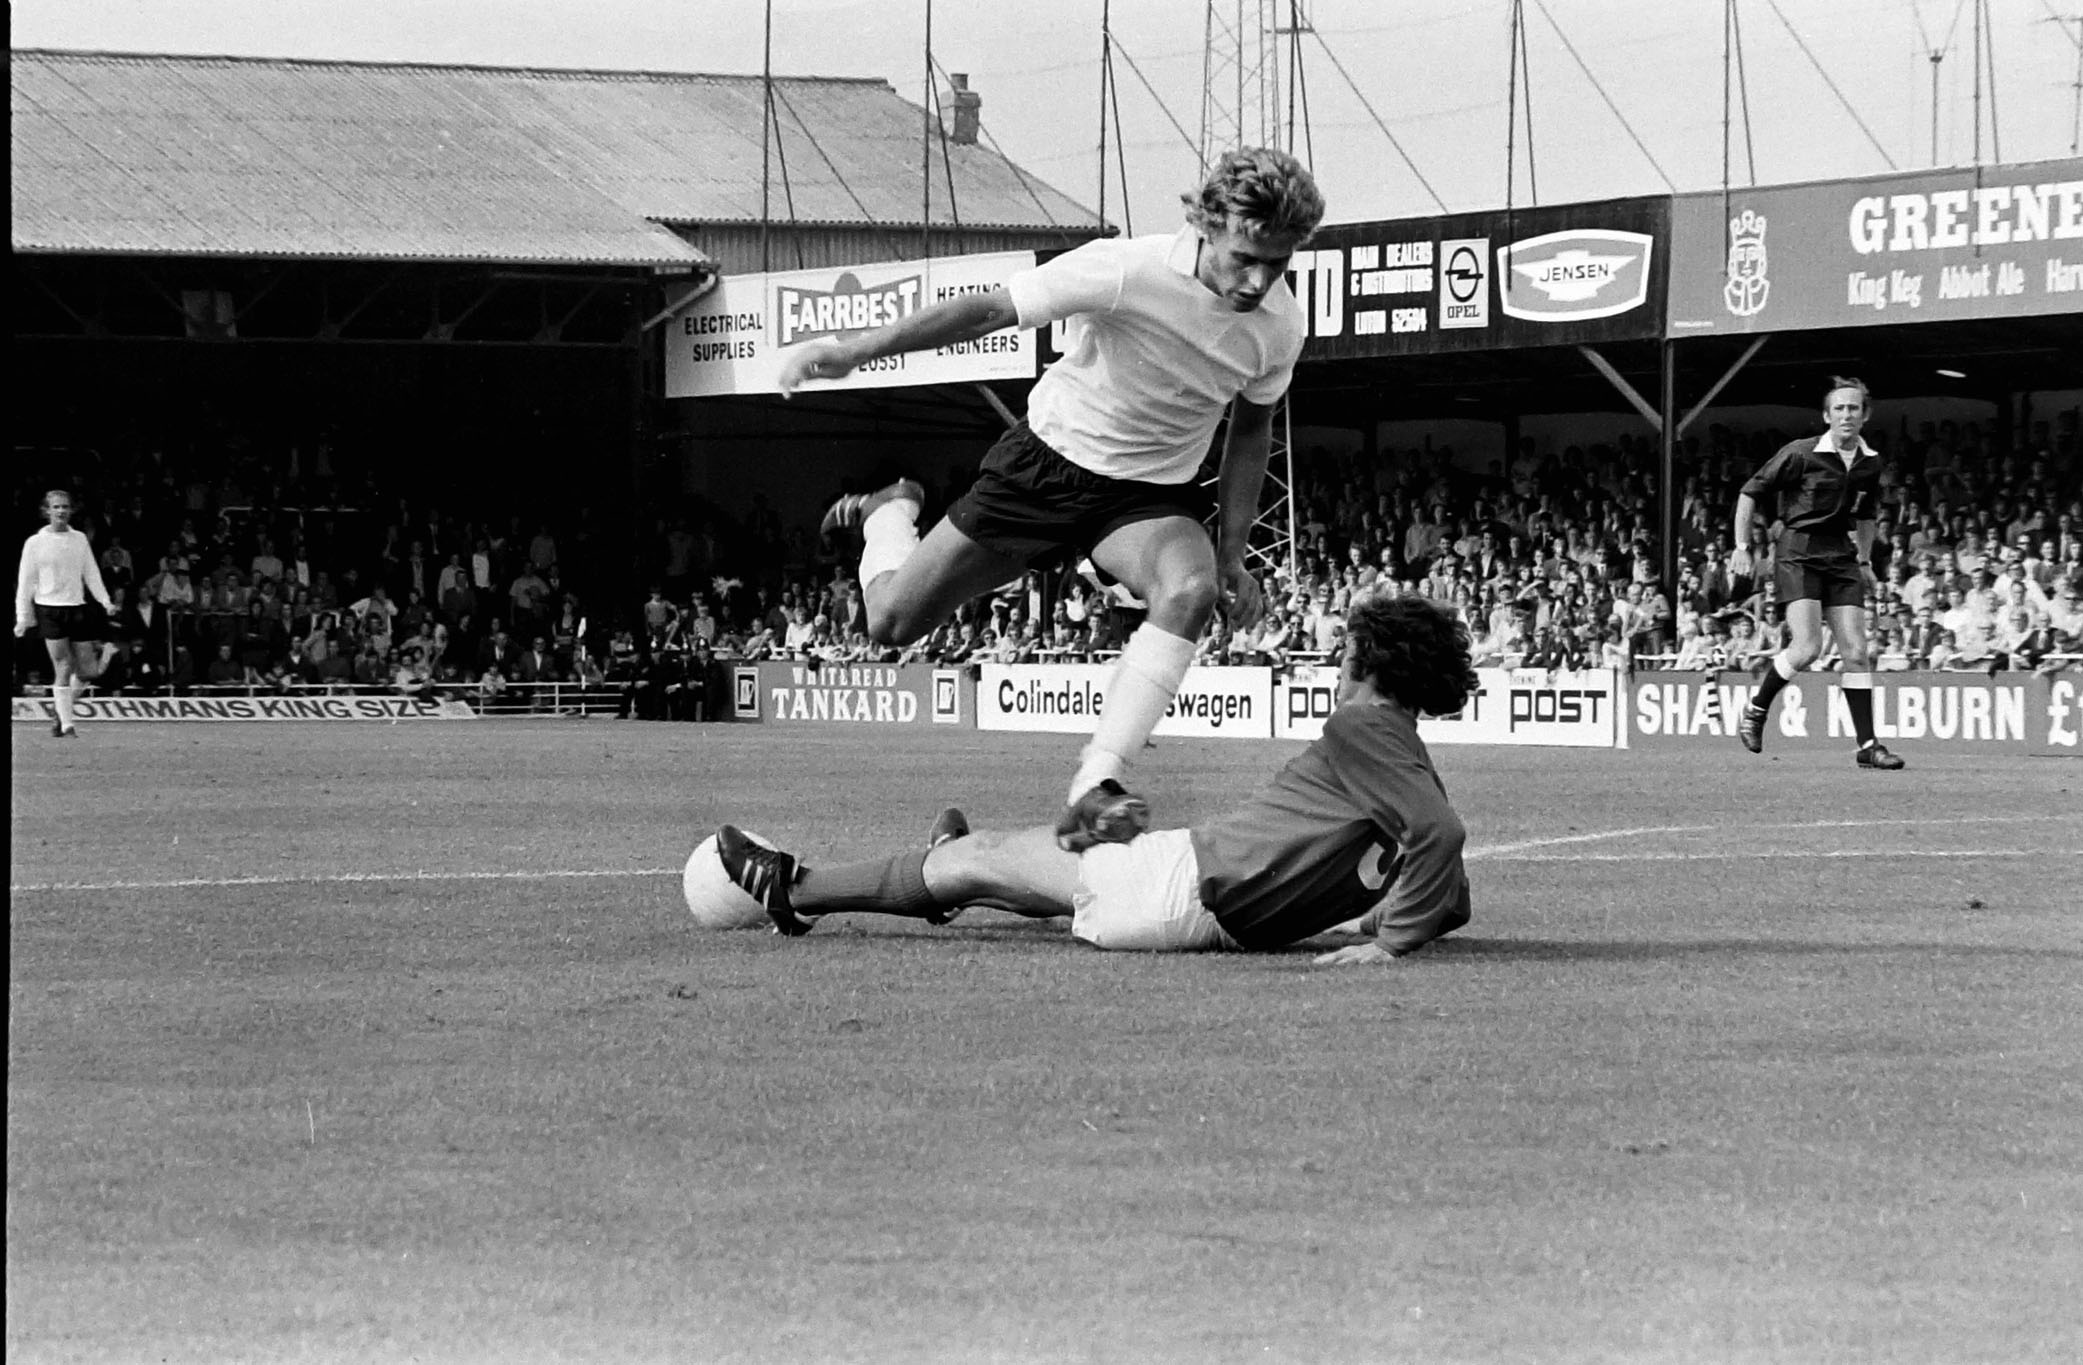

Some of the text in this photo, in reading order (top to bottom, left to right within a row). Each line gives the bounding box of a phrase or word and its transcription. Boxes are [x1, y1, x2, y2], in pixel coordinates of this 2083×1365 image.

[1849, 181, 2083, 255] GREENE
[1539, 263, 1609, 282] JENSEN
[782, 278, 918, 343] FARRBEST
[1447, 304, 1480, 319] OPEL
[685, 312, 763, 336] ELECTRICAL
[692, 343, 756, 363] SUPPLIES
[937, 334, 1020, 357] ENGINEERS
[771, 687, 918, 722] TANKARD
[999, 678, 1103, 715] Colindale
[39, 699, 441, 719] ROTHMANS KING SIZE
[1636, 683, 2026, 740] SHAW & KLBURN
